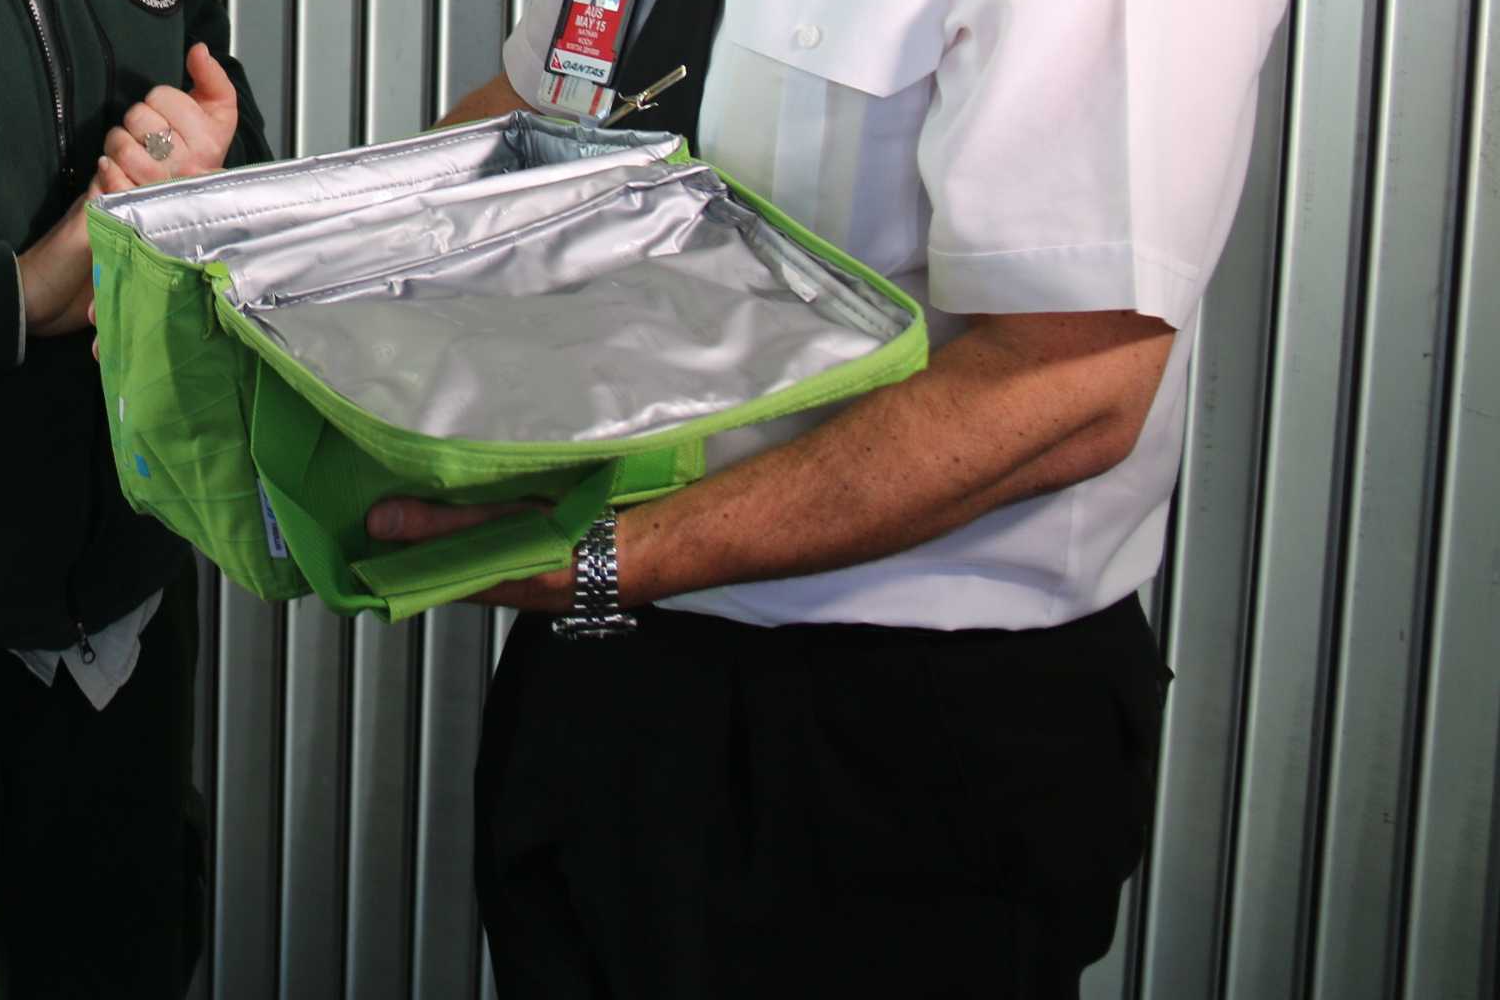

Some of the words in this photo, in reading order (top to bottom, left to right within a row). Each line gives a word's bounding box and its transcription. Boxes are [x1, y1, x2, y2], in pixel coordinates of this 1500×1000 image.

[584, 6, 604, 19] AUS
[575, 15, 596, 29] MAY
[563, 60, 605, 77] QANTAS
